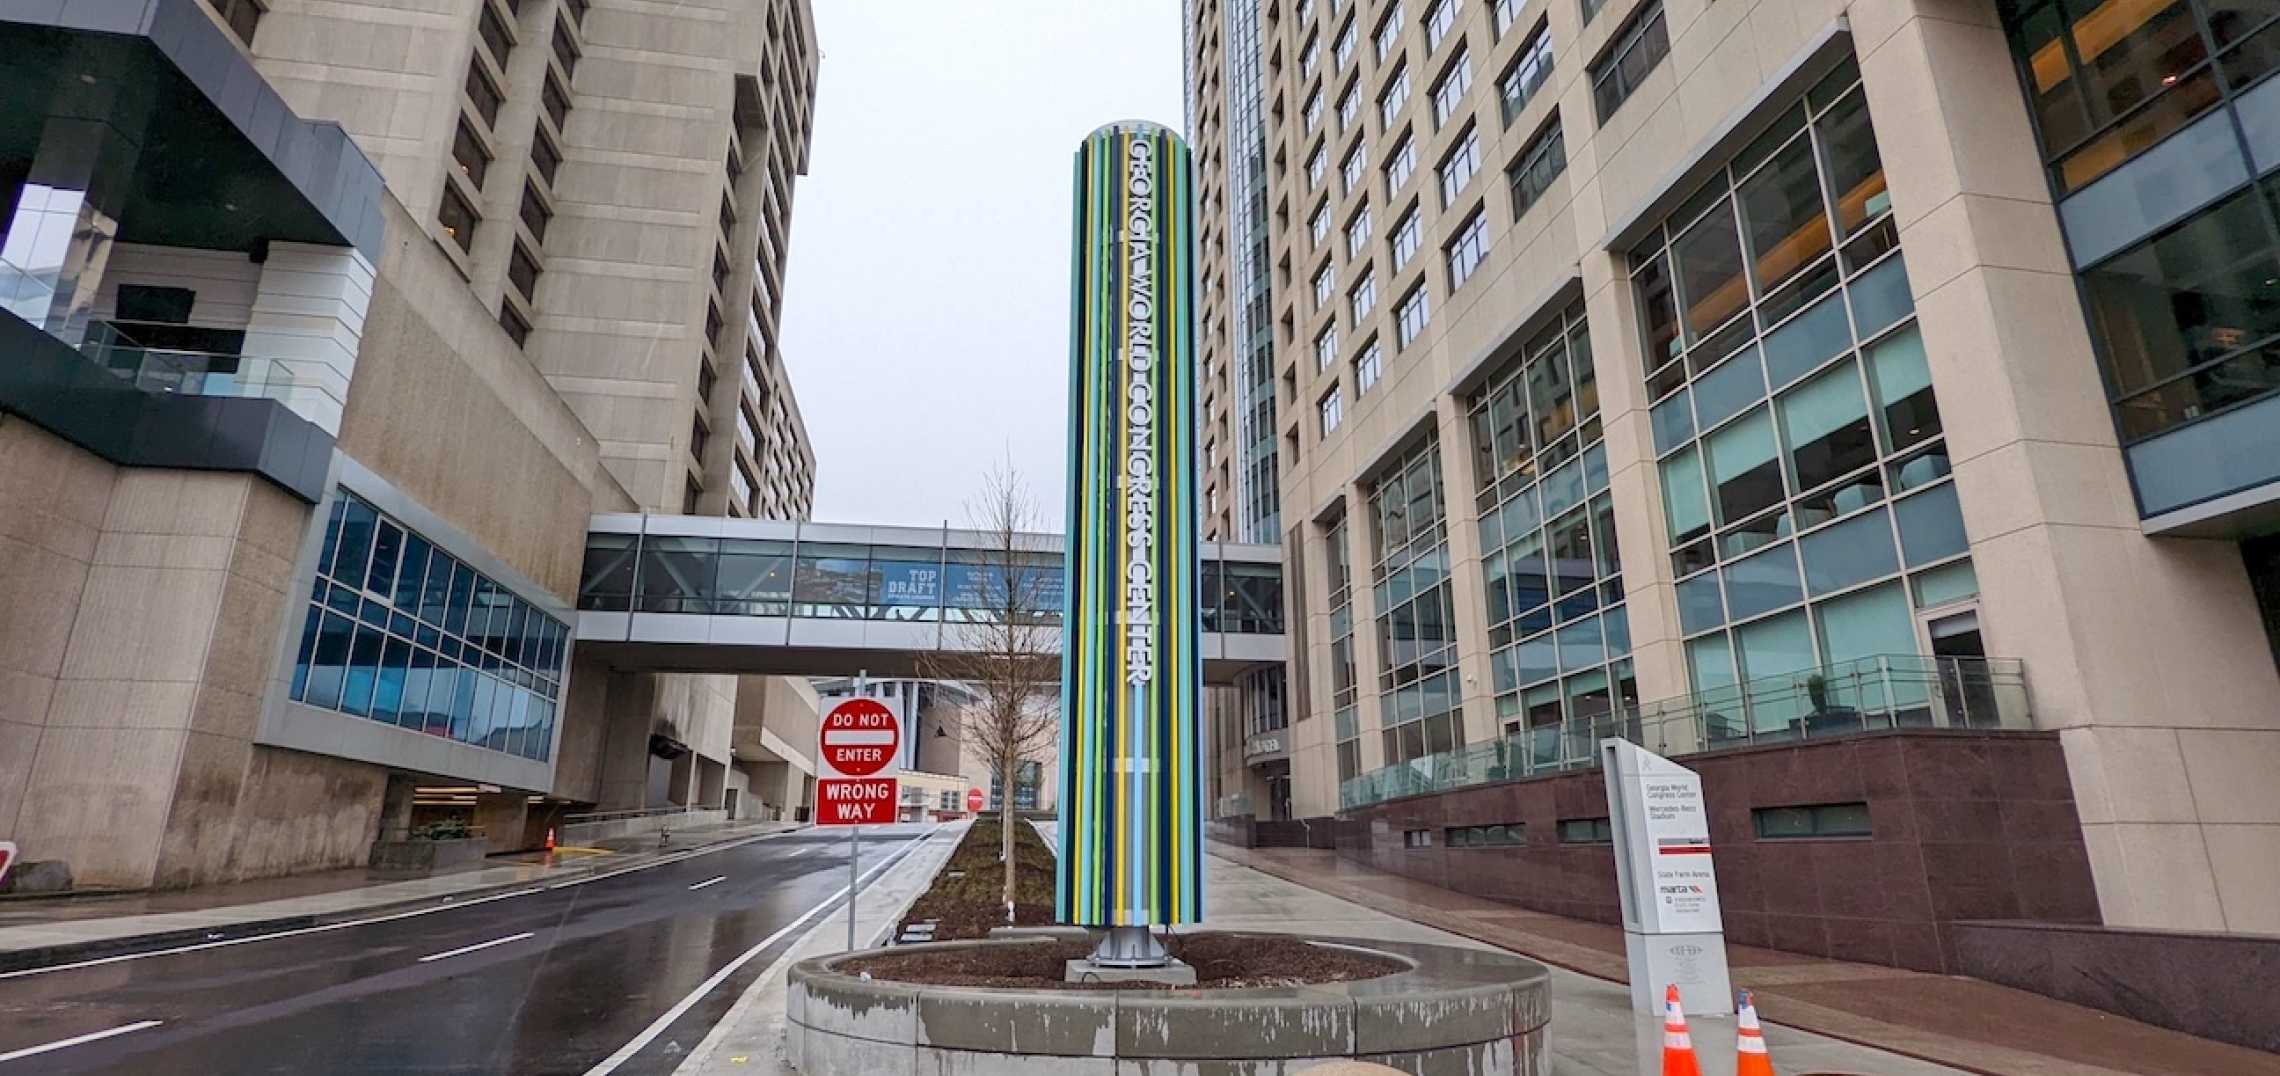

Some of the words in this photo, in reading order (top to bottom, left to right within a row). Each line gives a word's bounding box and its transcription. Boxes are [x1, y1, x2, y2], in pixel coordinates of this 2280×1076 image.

[1128, 138, 1153, 263] GEORGIA
[1128, 269, 1153, 373] WORLD
[1127, 383, 1153, 549] CONGRESS
[908, 569, 937, 582] TOP
[888, 581, 937, 595] DRAFT
[1127, 562, 1152, 685] CENTER
[833, 713, 853, 727] DO
[860, 713, 889, 727] NOT
[836, 748, 883, 762] ENTER
[826, 783, 889, 800] WRONG
[837, 802, 876, 820] WAY
[1660, 885, 1688, 894] marta
